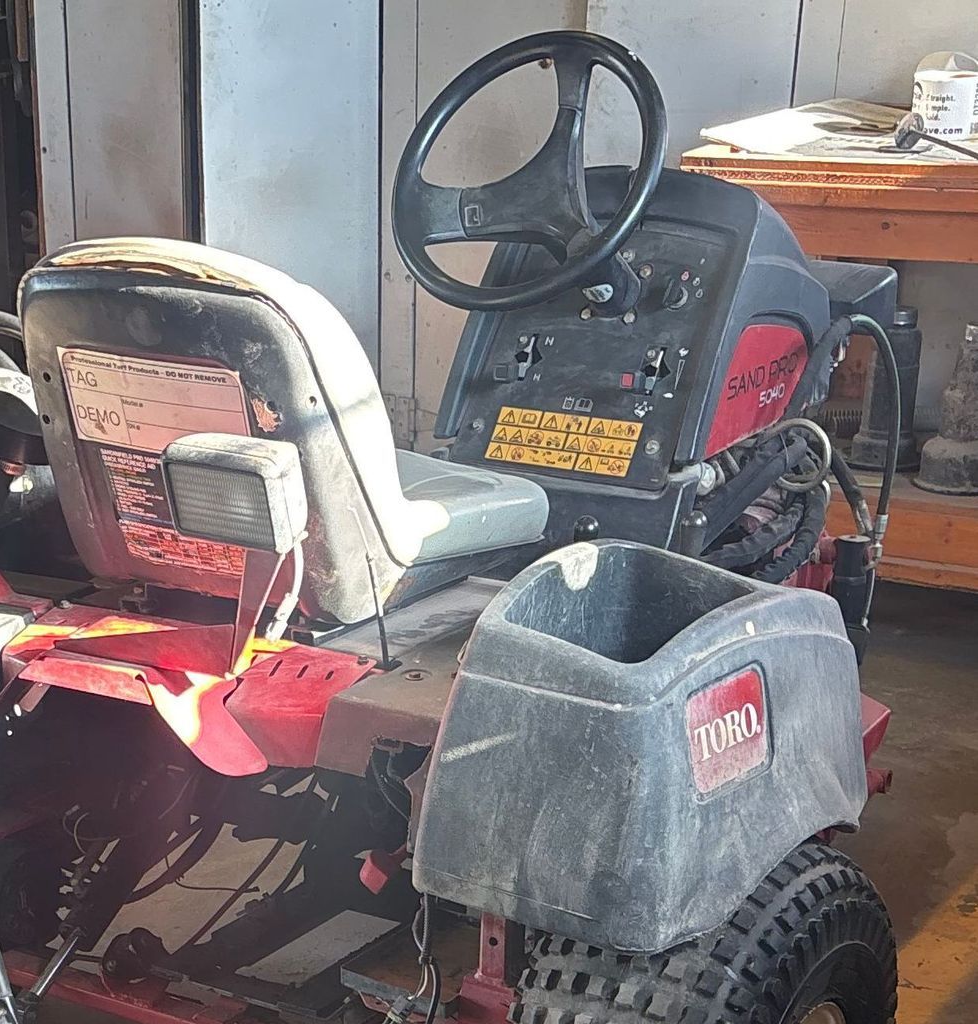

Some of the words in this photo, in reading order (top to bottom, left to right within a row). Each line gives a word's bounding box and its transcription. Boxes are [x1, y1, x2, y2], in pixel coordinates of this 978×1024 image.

[66, 367, 98, 388] TAG
[194, 374, 227, 384] REMOVE
[727, 365, 765, 400] SAND
[768, 352, 798, 384] PRO
[758, 383, 786, 408] 5040
[76, 405, 120, 426] DEMO
